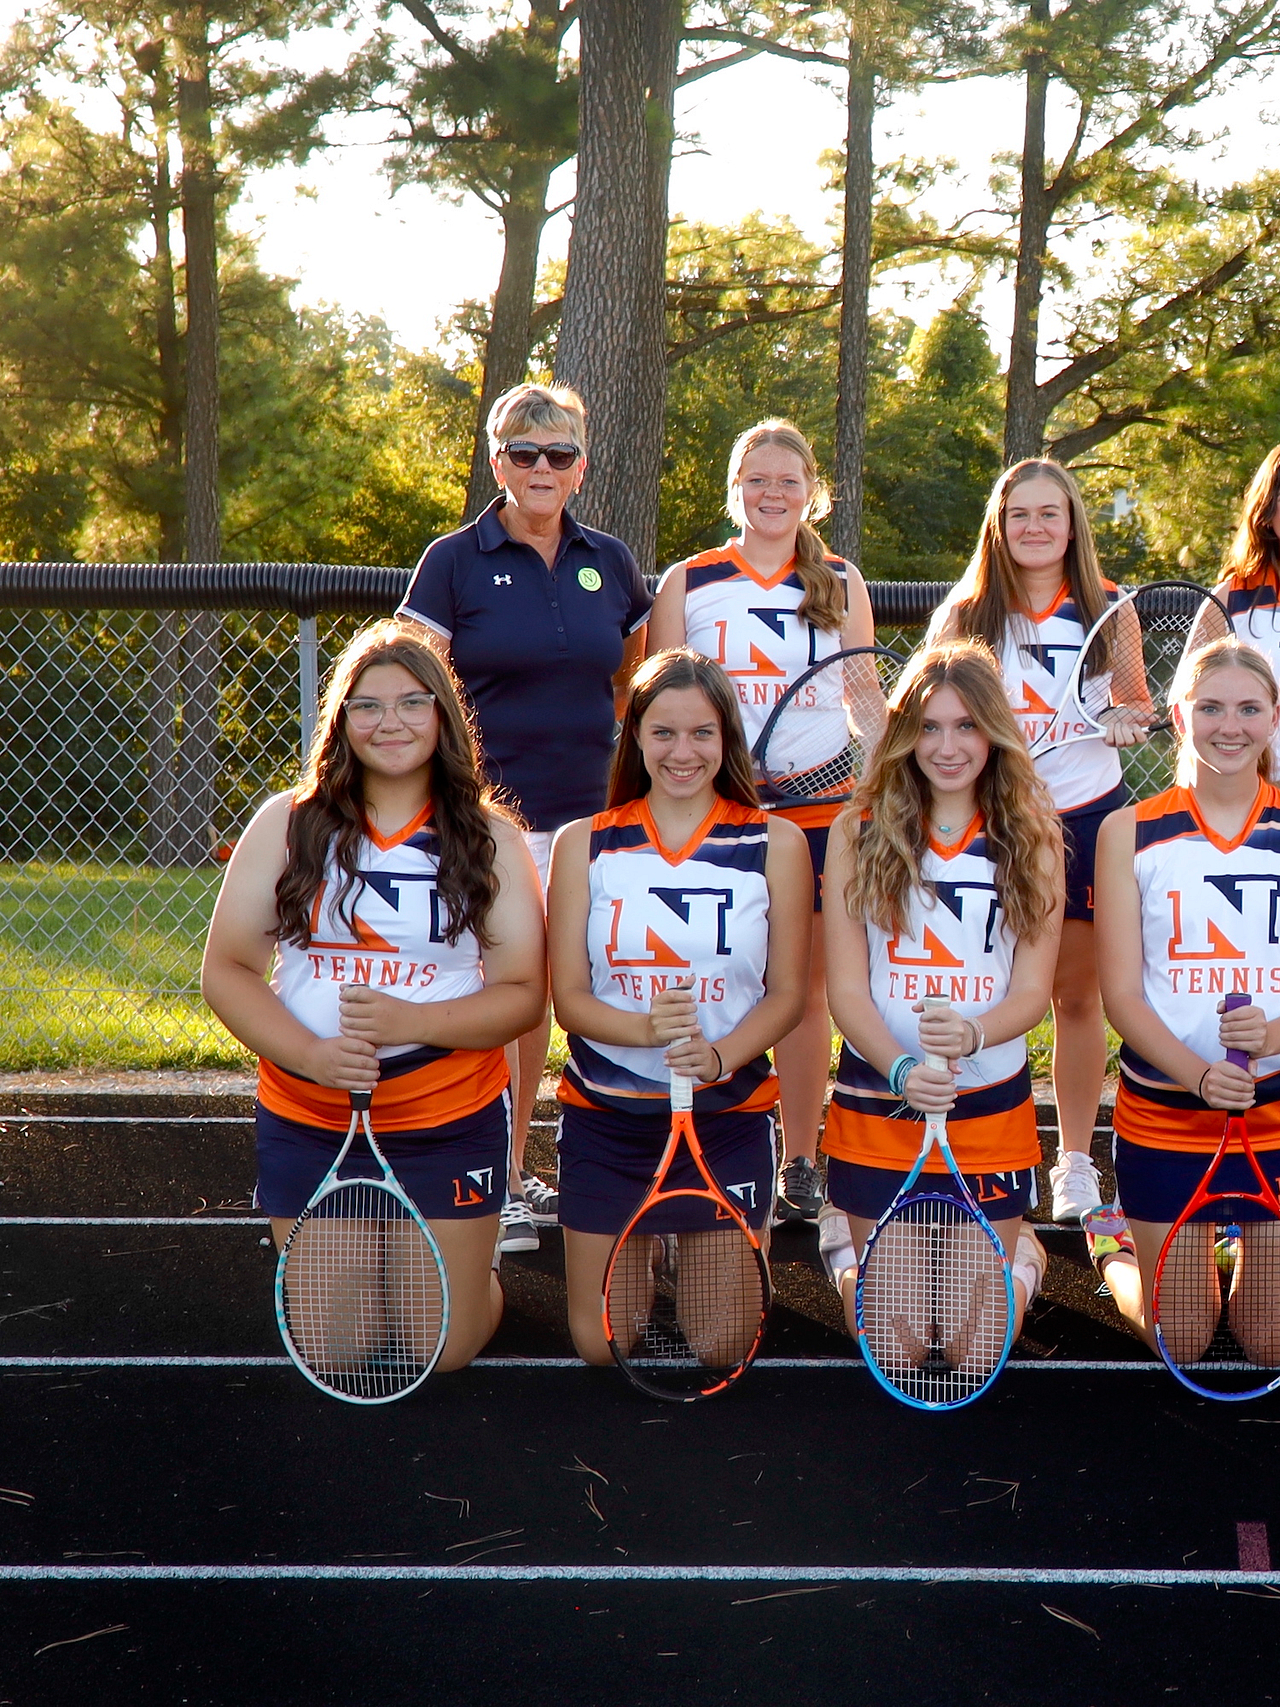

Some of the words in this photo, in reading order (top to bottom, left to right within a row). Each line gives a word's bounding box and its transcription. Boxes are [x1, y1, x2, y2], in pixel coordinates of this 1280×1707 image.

[307, 953, 438, 988] TENNIS
[611, 973, 725, 1003] TENIS
[889, 971, 995, 1002] TENNIS
